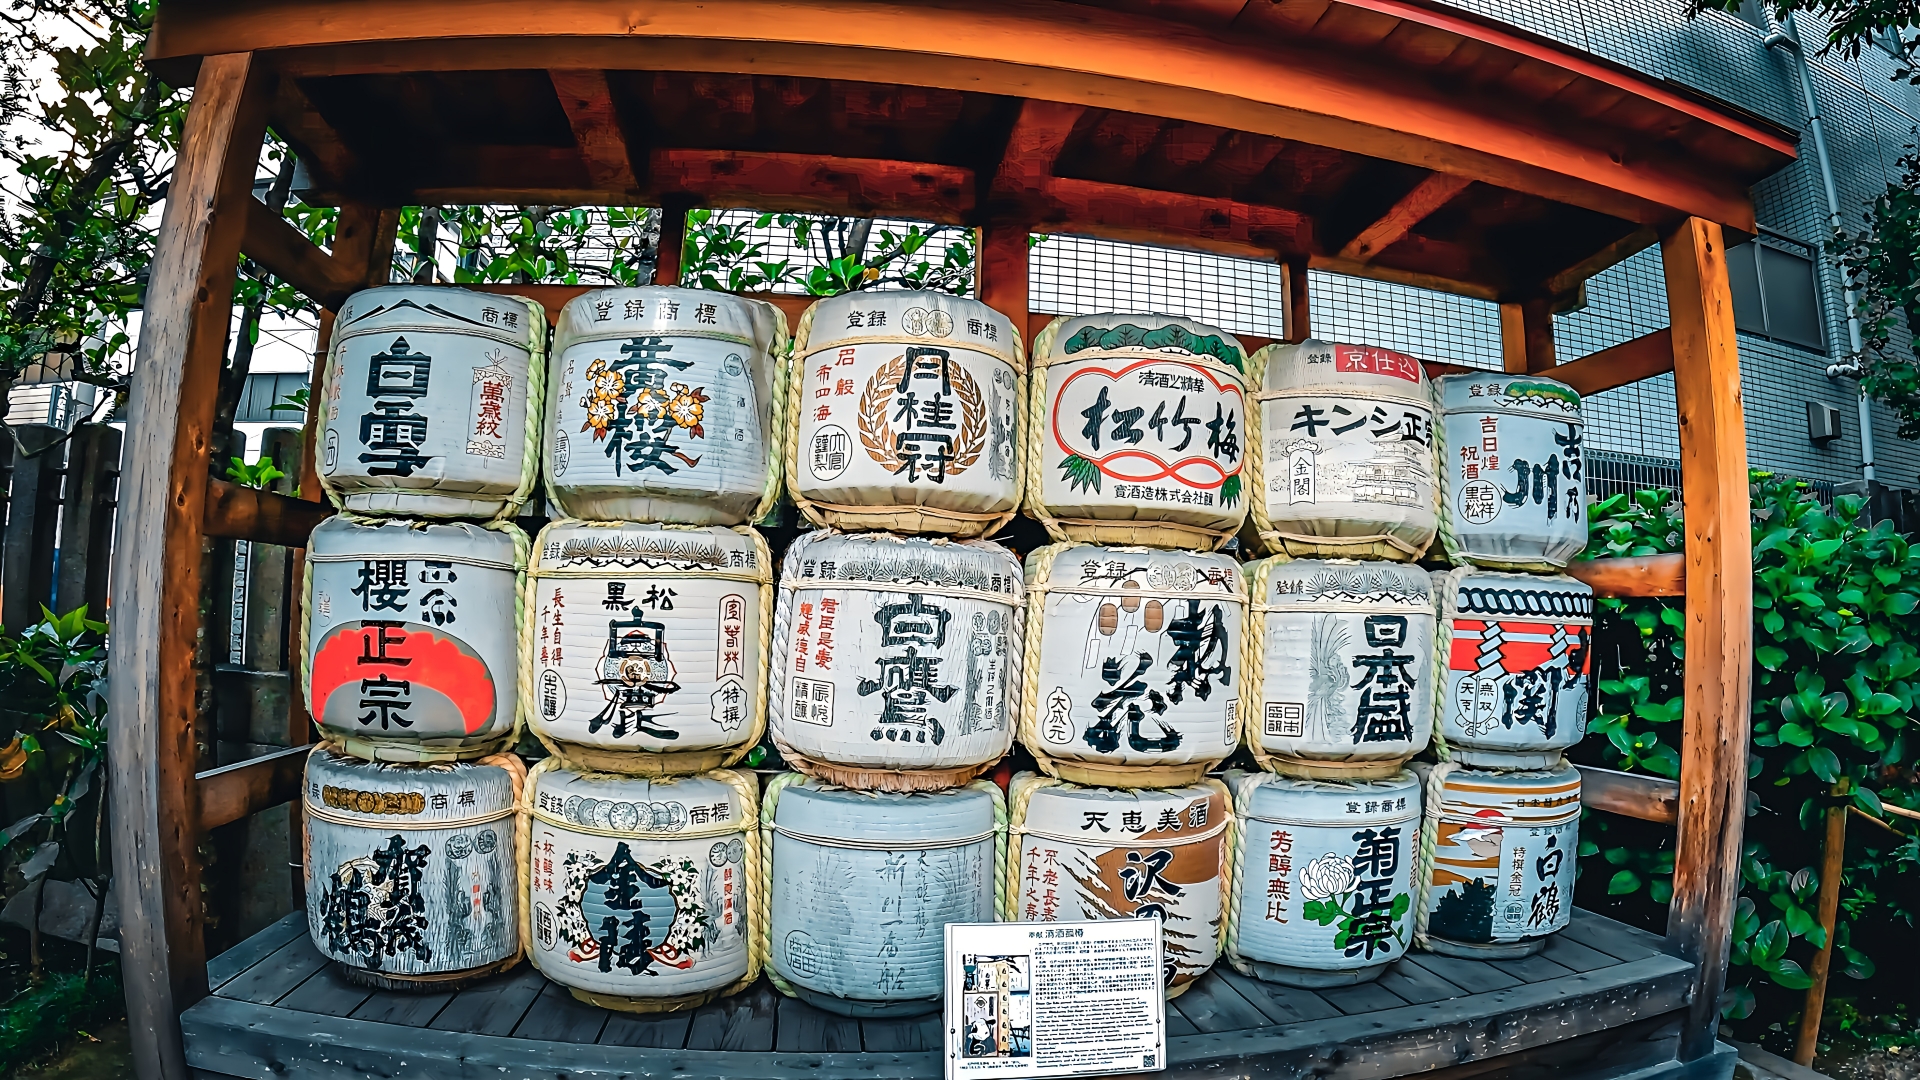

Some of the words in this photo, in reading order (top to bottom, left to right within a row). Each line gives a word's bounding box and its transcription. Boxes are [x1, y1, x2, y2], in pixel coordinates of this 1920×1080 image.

[481, 306, 519, 329] 商標
[594, 299, 718, 325] 登録商標
[847, 309, 888, 330] 登録
[966, 318, 998, 343] 商標
[1343, 350, 1417, 380] 京仕込
[357, 335, 434, 478] 白雪
[1468, 383, 1503, 398] 登録
[893, 346, 957, 484] 月桂冠
[1081, 386, 1240, 464] 松竹梅
[1293, 457, 1313, 497] 金閣
[1460, 445, 1480, 480] 祝酒
[1464, 486, 1480, 519] 黒松
[1479, 485, 1495, 519] 吉祥
[602, 581, 679, 612] 黒松
[351, 560, 414, 731] 櫻正宗
[588, 606, 682, 740] 白鹿
[1350, 615, 1418, 745] 日本盛
[721, 688, 741, 723] 特撰
[1048, 695, 1067, 742] 大成元
[1283, 707, 1300, 734] 日本
[429, 790, 476, 810] 商標
[689, 802, 731, 826] 商標
[1080, 803, 1209, 834] 天恵美酒
[1264, 829, 1294, 925] 芳醇無比
[1344, 827, 1402, 960] 菊正宗
[1527, 834, 1564, 930] 白鶴
